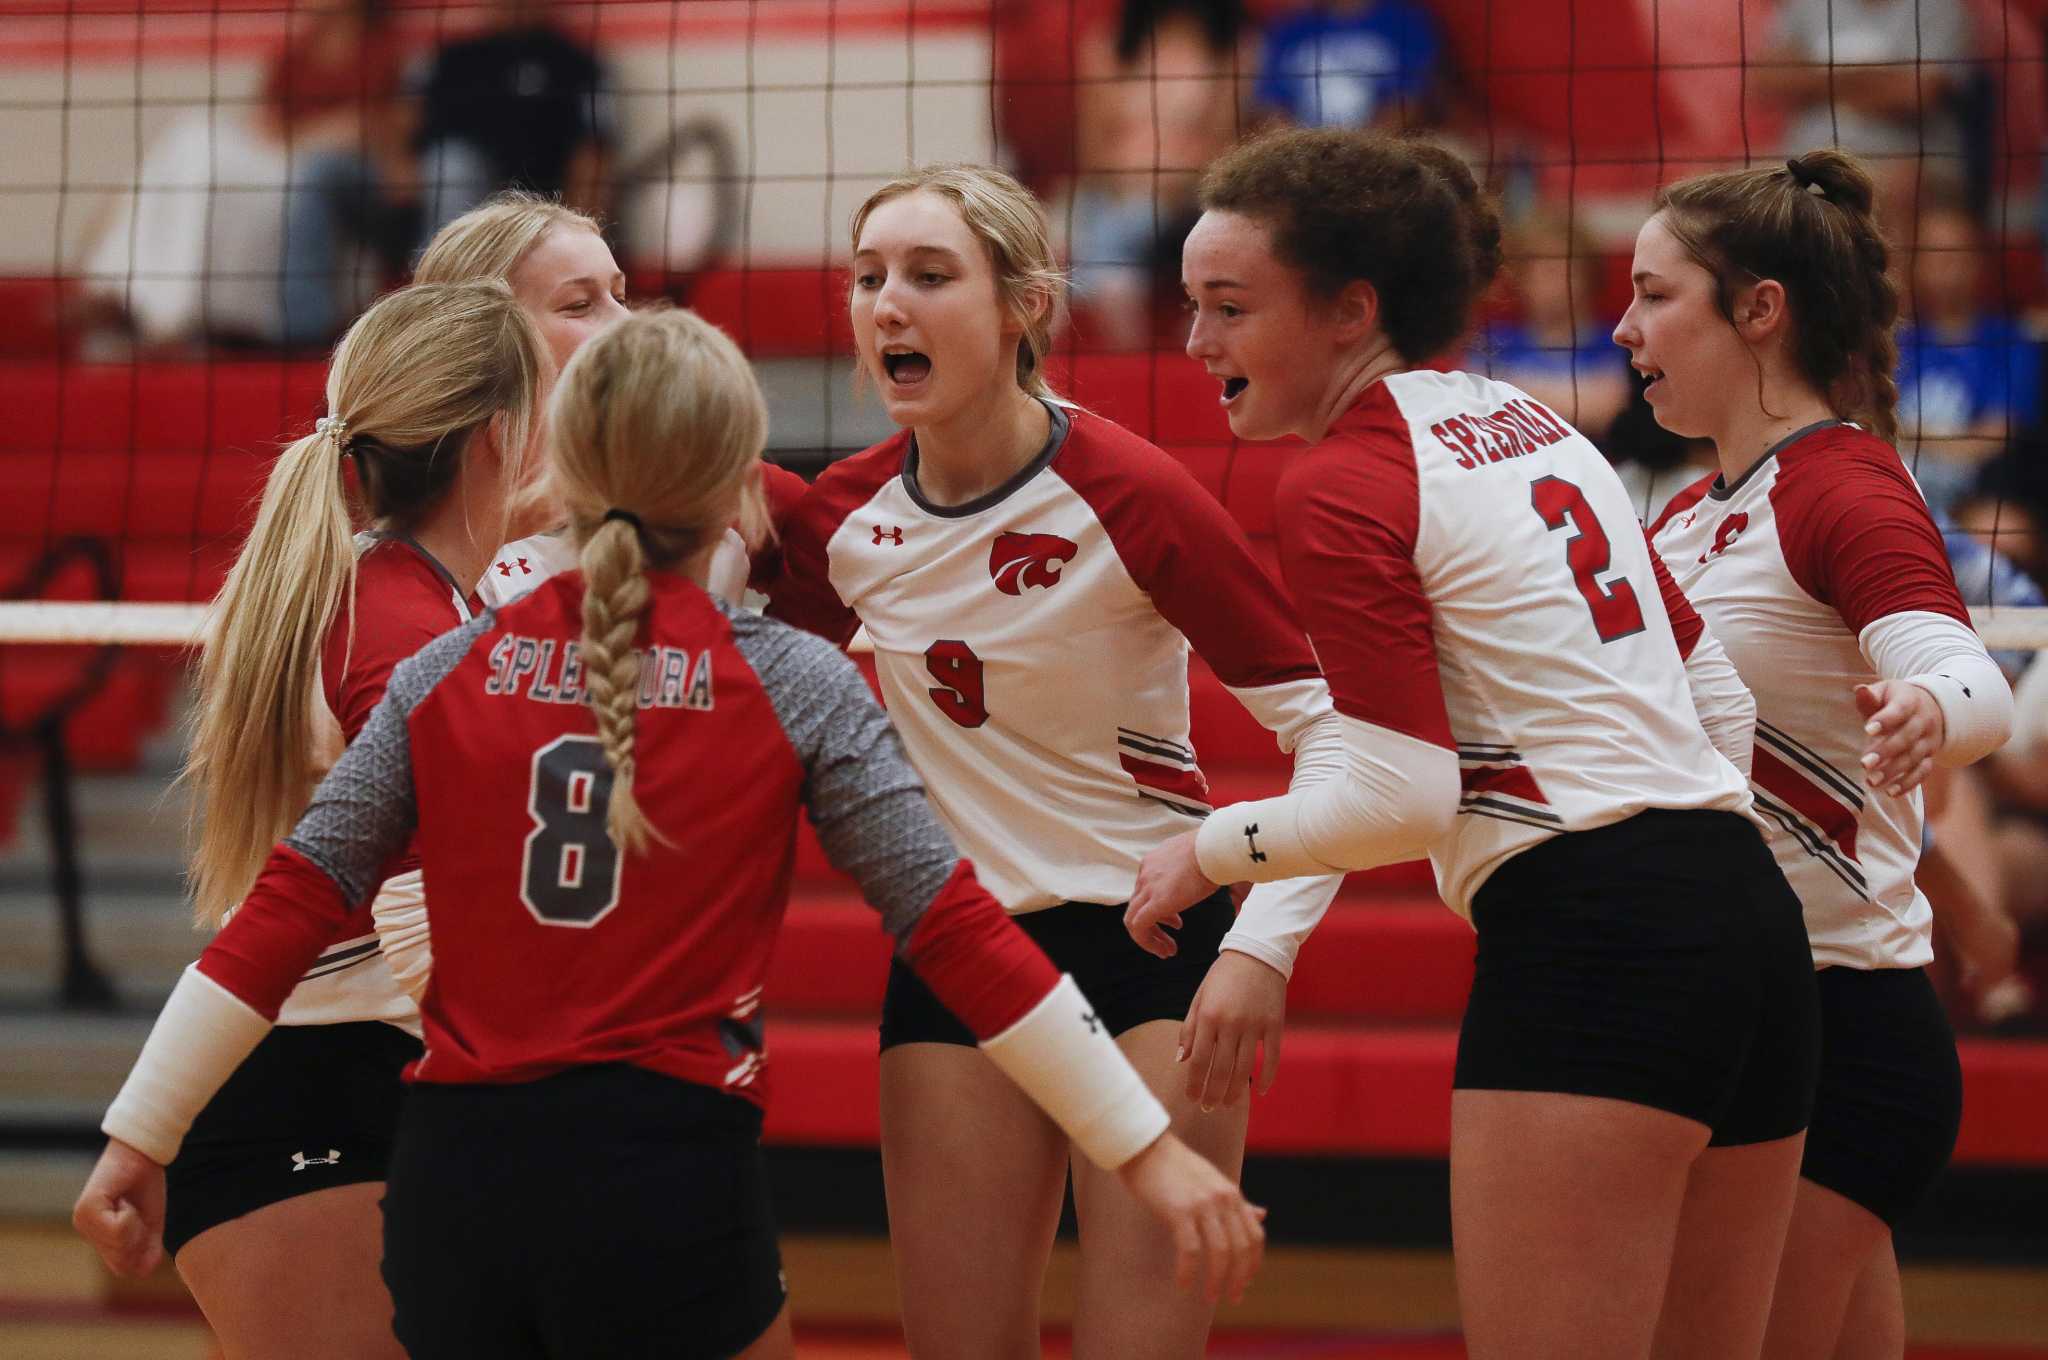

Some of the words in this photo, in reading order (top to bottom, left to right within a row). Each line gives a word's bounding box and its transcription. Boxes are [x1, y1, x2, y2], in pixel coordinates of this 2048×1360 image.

[1530, 474, 1647, 644] 2
[485, 632, 715, 712] SPLEORA
[924, 639, 990, 728] 9
[520, 733, 624, 929] 8
